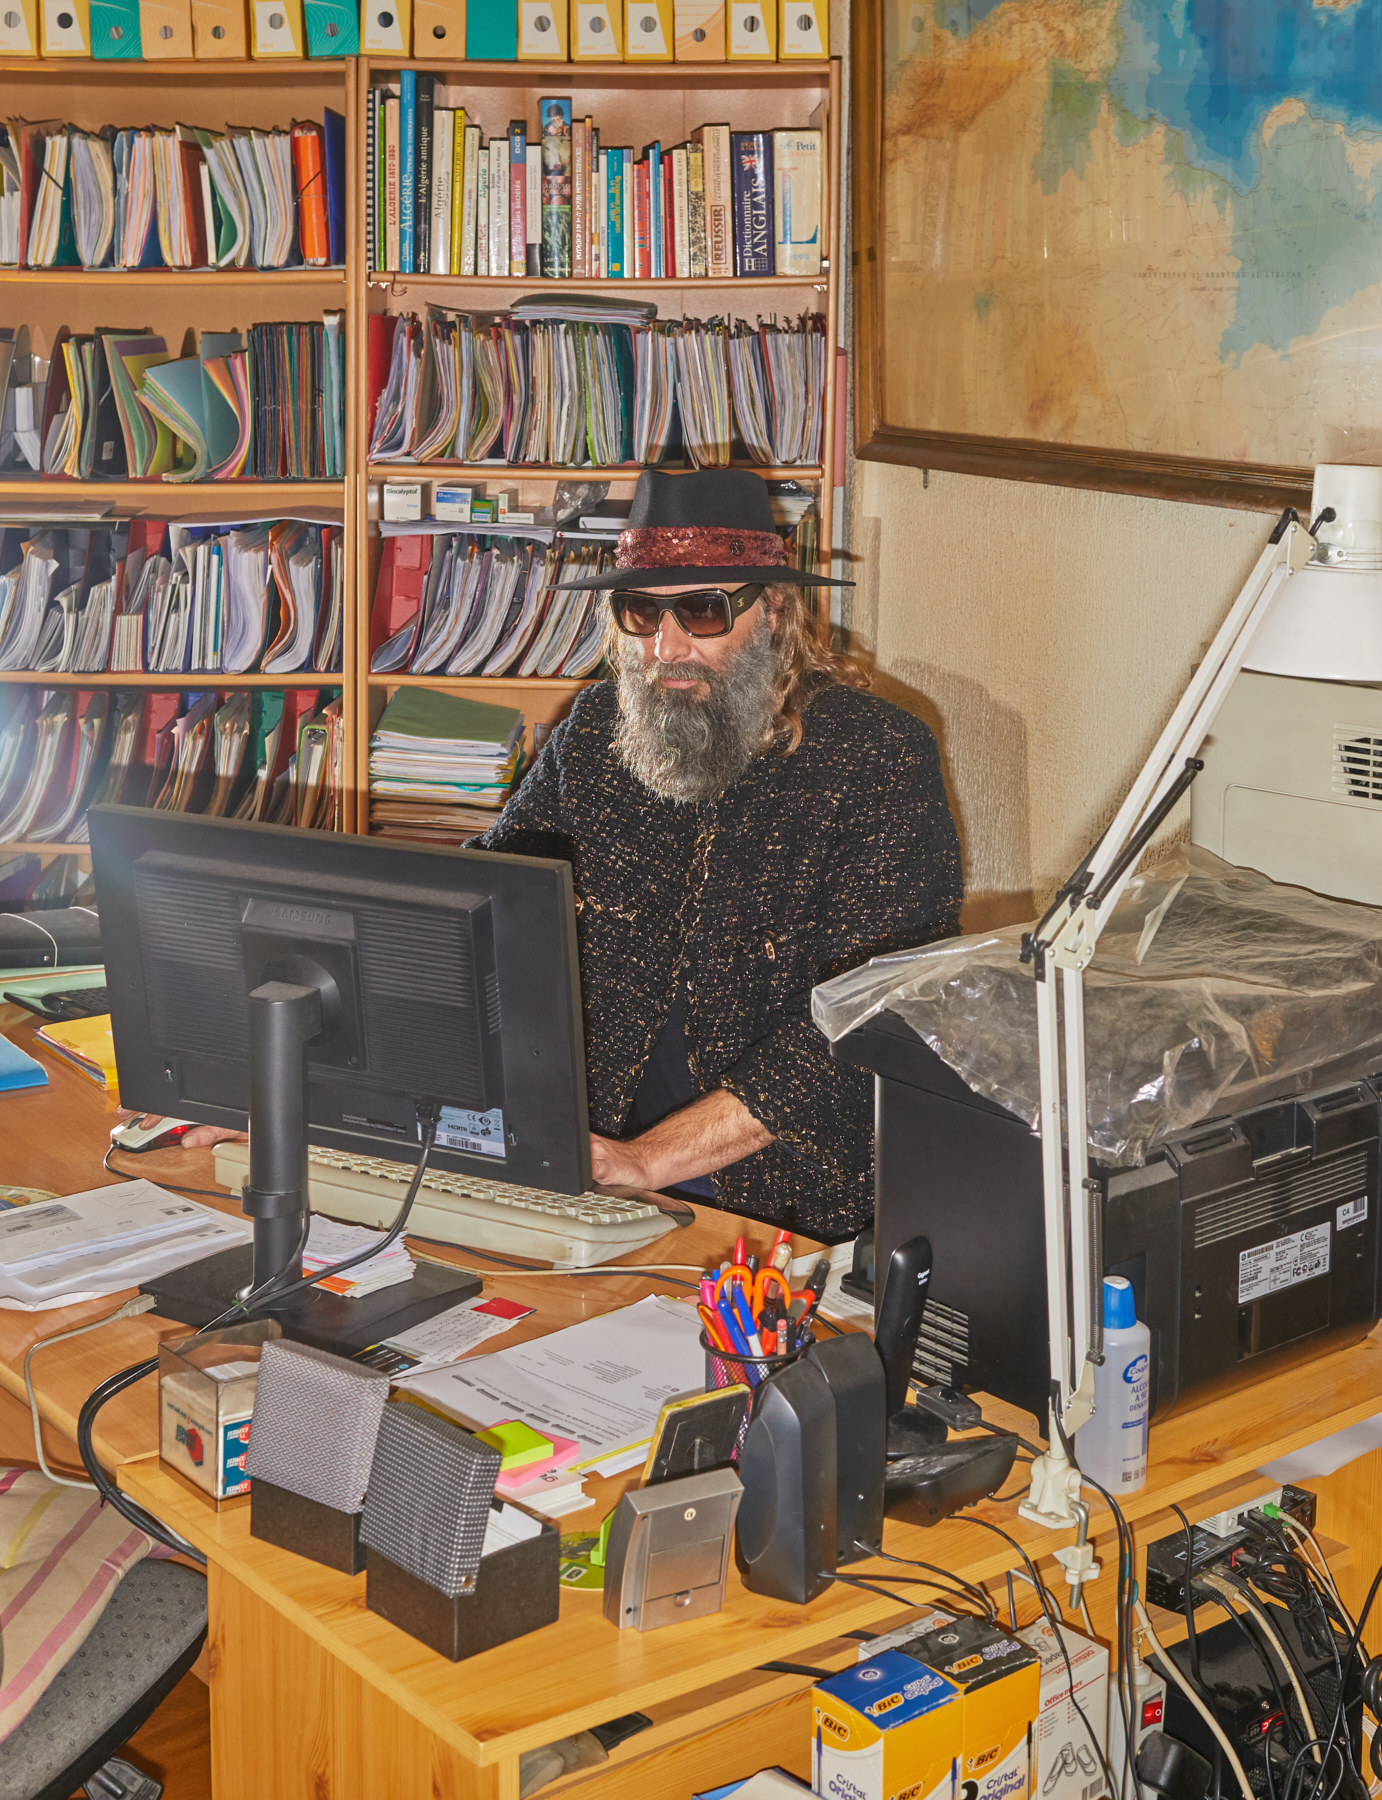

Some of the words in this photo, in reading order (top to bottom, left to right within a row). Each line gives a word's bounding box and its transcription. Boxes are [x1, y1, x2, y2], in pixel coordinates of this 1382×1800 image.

[420, 127, 430, 160] antique
[796, 141, 816, 151] Petit
[418, 162, 430, 203] L'Algérie
[479, 168, 488, 198] Algérie
[513, 180, 521, 209] sociétés
[433, 177, 446, 221] Algérie
[776, 167, 818, 245] L
[741, 191, 753, 257] Dictionnaire
[752, 178, 768, 257] ANGLAIS
[514, 224, 522, 242] Droit
[712, 207, 724, 261] REUSSIR
[386, 488, 418, 496] Biocalyptol
[273, 907, 331, 925] SAMSUNG
[1342, 1207, 1350, 1216] C4
[1043, 1651, 1062, 1666] aper
[1075, 1650, 1095, 1664] Office
[1044, 1690, 1064, 1707] Office
[986, 1768, 1018, 1790] Cristal
